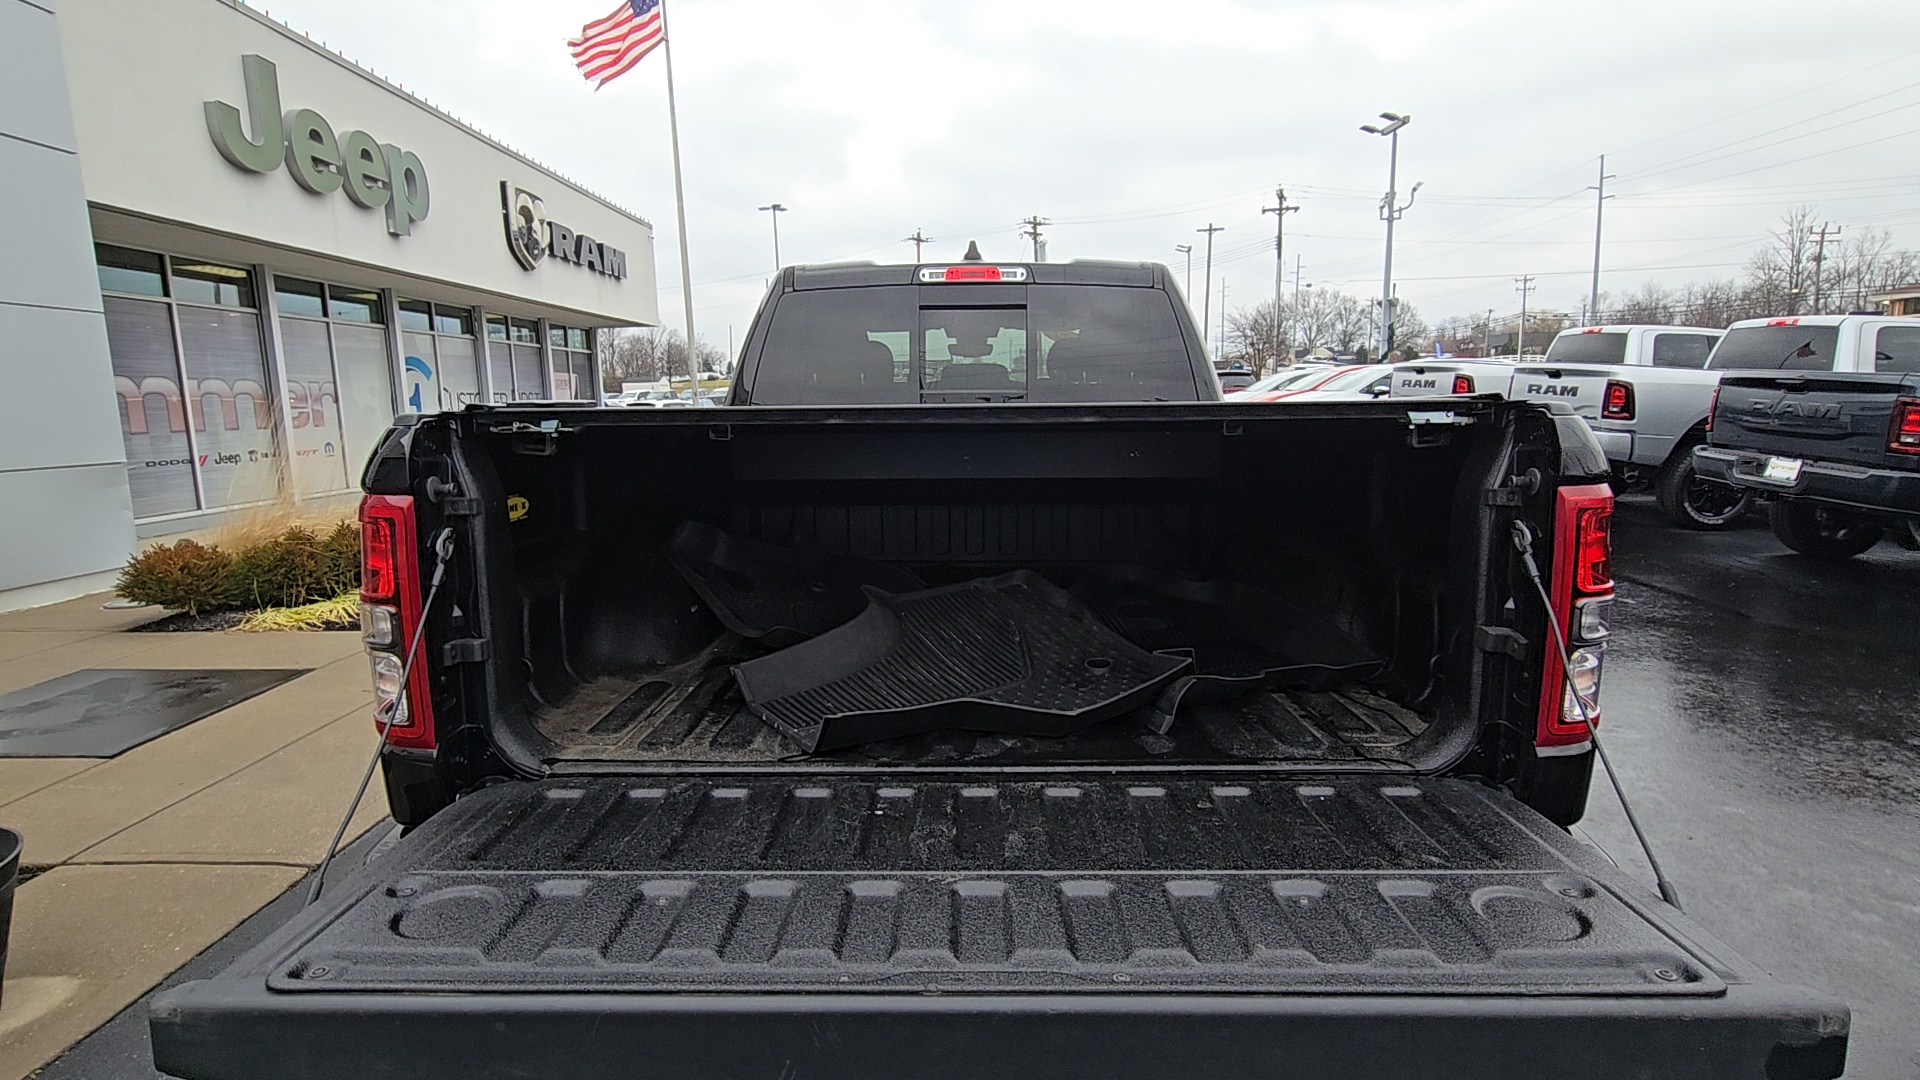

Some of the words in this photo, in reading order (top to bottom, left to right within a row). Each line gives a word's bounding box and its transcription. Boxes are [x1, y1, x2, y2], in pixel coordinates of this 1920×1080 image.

[203, 54, 430, 237] Jeep
[548, 220, 628, 280] RAM
[1401, 379, 1437, 389] RAM
[1527, 383, 1580, 398] RAM
[440, 387, 508, 411] USTOER
[1748, 398, 1842, 418] RAM
[145, 458, 193, 467] DODG
[214, 452, 242, 466] Jeep
